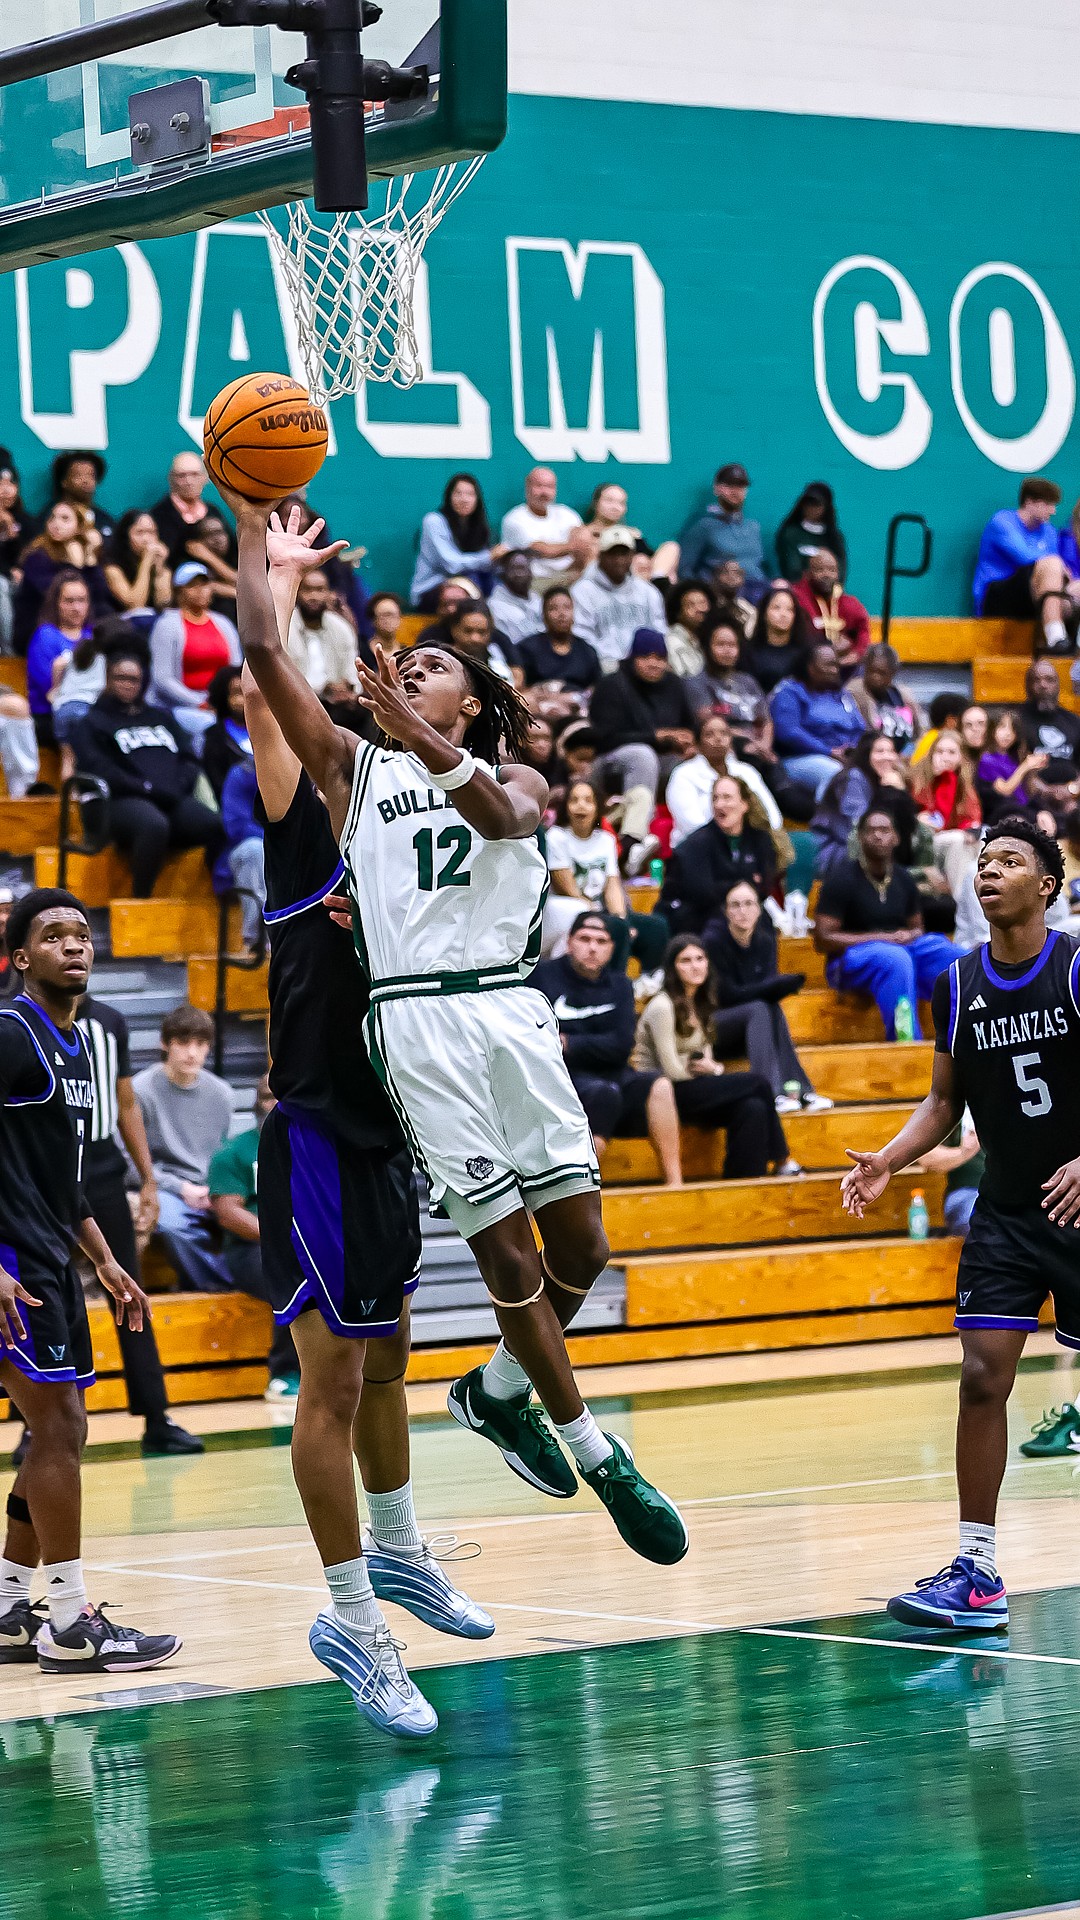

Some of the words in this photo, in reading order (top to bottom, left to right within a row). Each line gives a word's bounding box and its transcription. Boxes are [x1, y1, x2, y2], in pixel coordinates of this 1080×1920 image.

[15, 222, 672, 464] PALM
[258, 409, 327, 432] Wilson
[412, 824, 472, 891] 12
[972, 1006, 1069, 1051] MATANZAS
[1011, 1051, 1053, 1117] 5
